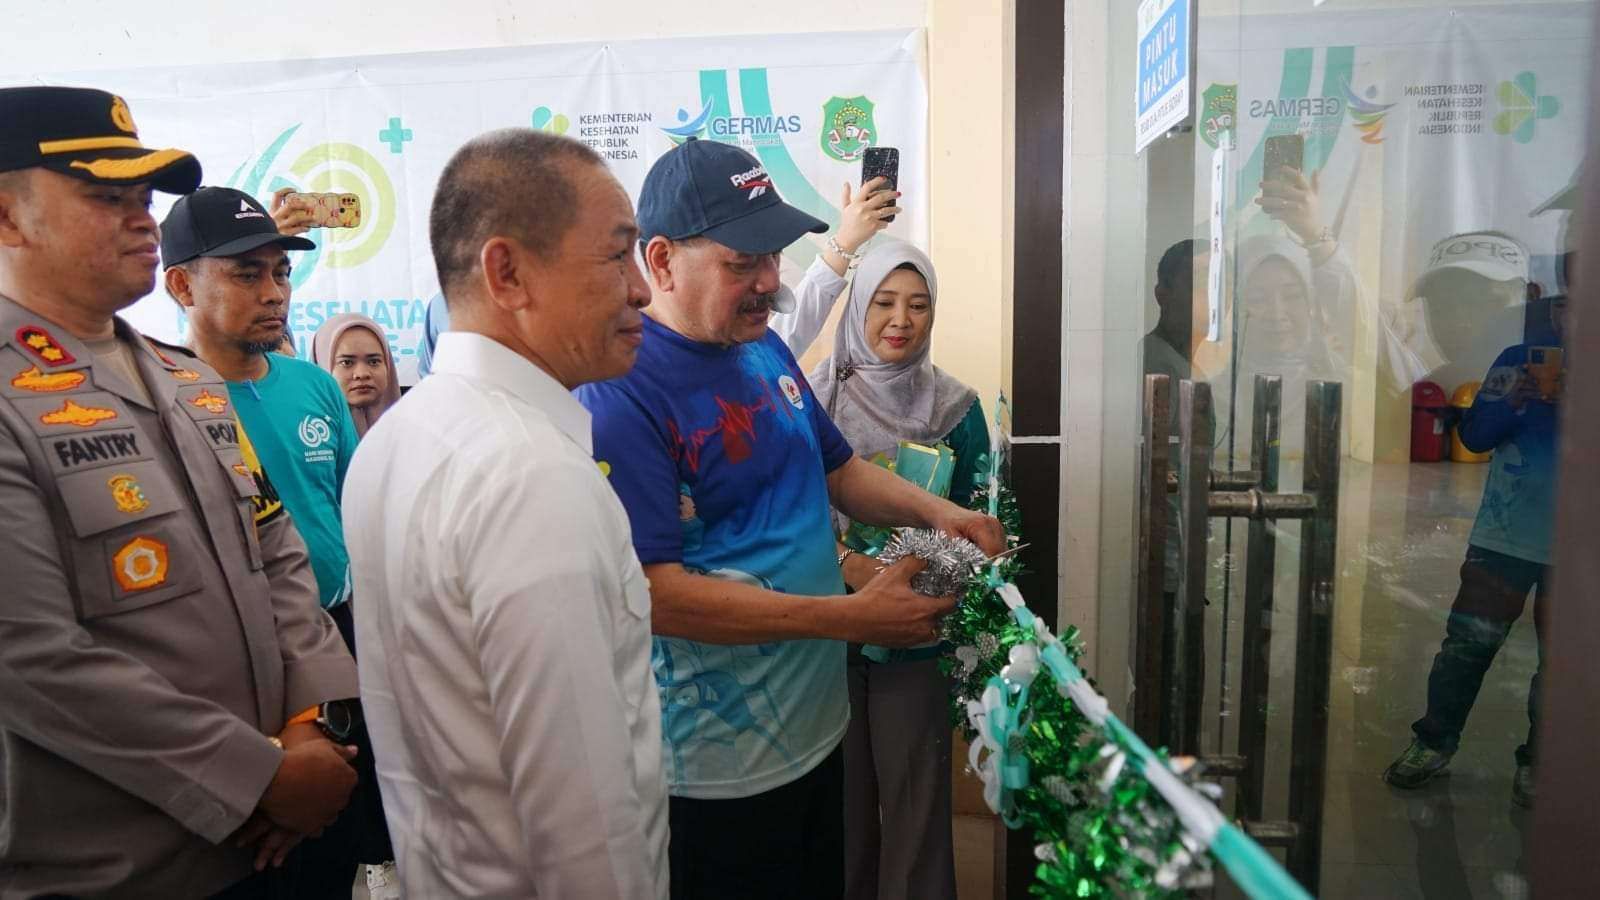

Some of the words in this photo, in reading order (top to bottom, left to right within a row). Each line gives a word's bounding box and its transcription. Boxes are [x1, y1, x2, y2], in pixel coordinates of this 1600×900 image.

[1145, 13, 1177, 71] PINTU
[1143, 48, 1178, 105] MASUK
[580, 112, 652, 125] KEMENTERIAN
[580, 126, 639, 137] KESEHATAN
[712, 115, 801, 135] GERMAS
[53, 432, 141, 467] FANTRY
